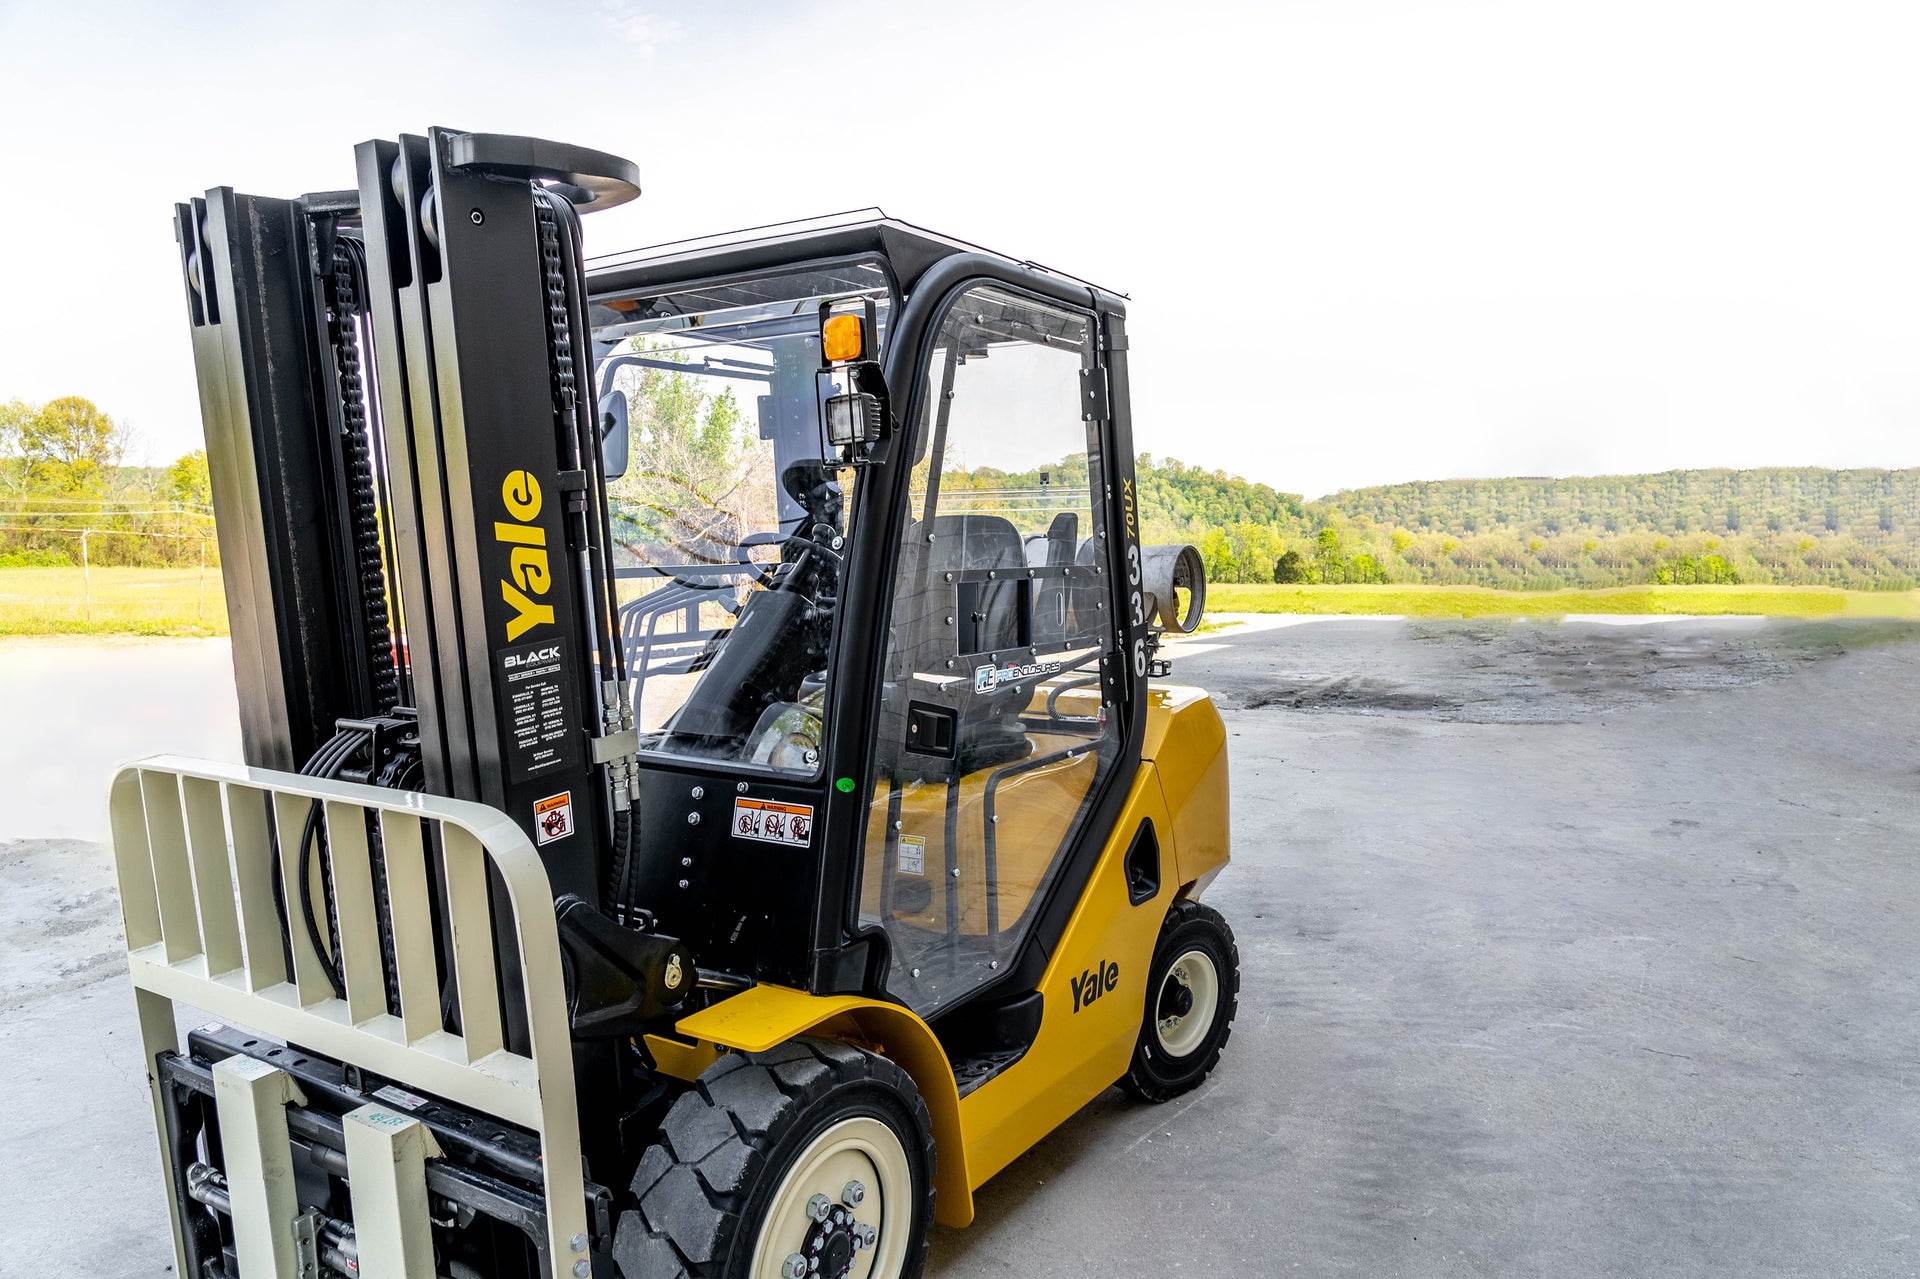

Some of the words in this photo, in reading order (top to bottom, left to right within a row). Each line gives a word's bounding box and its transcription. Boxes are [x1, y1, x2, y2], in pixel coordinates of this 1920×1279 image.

[1123, 476, 1136, 538] 70UX
[494, 470, 555, 642] Yale
[504, 646, 560, 668] BLACK
[547, 799, 566, 808] WARNING
[767, 804, 787, 812] WARNING
[1070, 959, 1119, 1014] Yale
